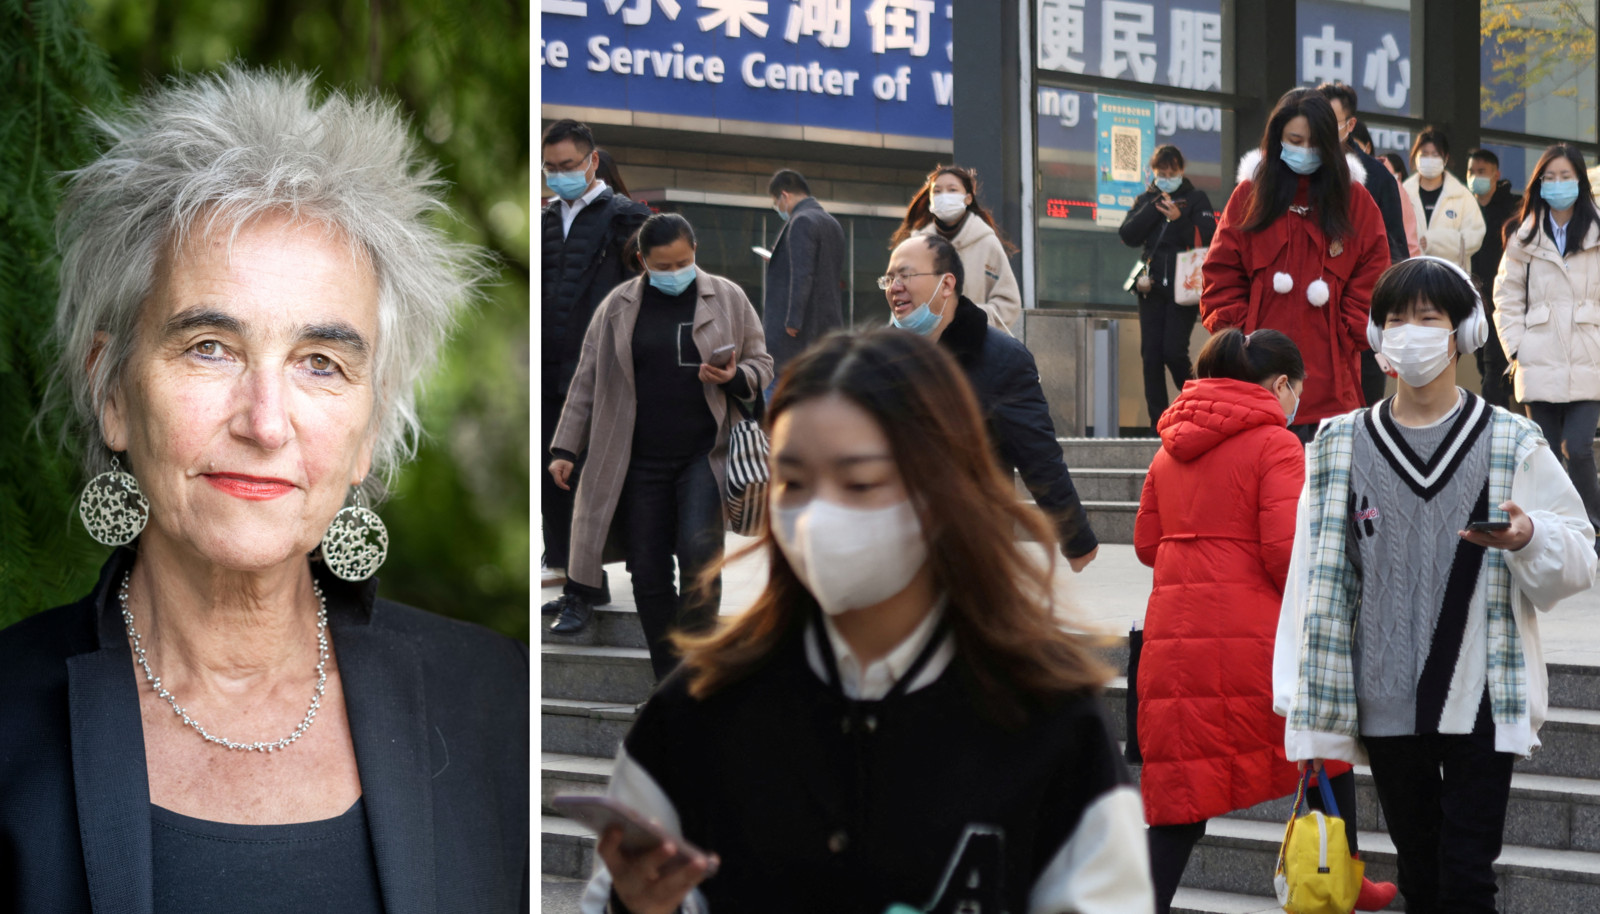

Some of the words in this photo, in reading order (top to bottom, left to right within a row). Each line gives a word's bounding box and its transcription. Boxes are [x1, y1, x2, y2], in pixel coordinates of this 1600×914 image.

[587, 35, 725, 83] Service
[741, 52, 859, 96] Center
[873, 66, 911, 101] of
[1038, 90, 1080, 128] ng
[1302, 25, 1410, 109] 中心
